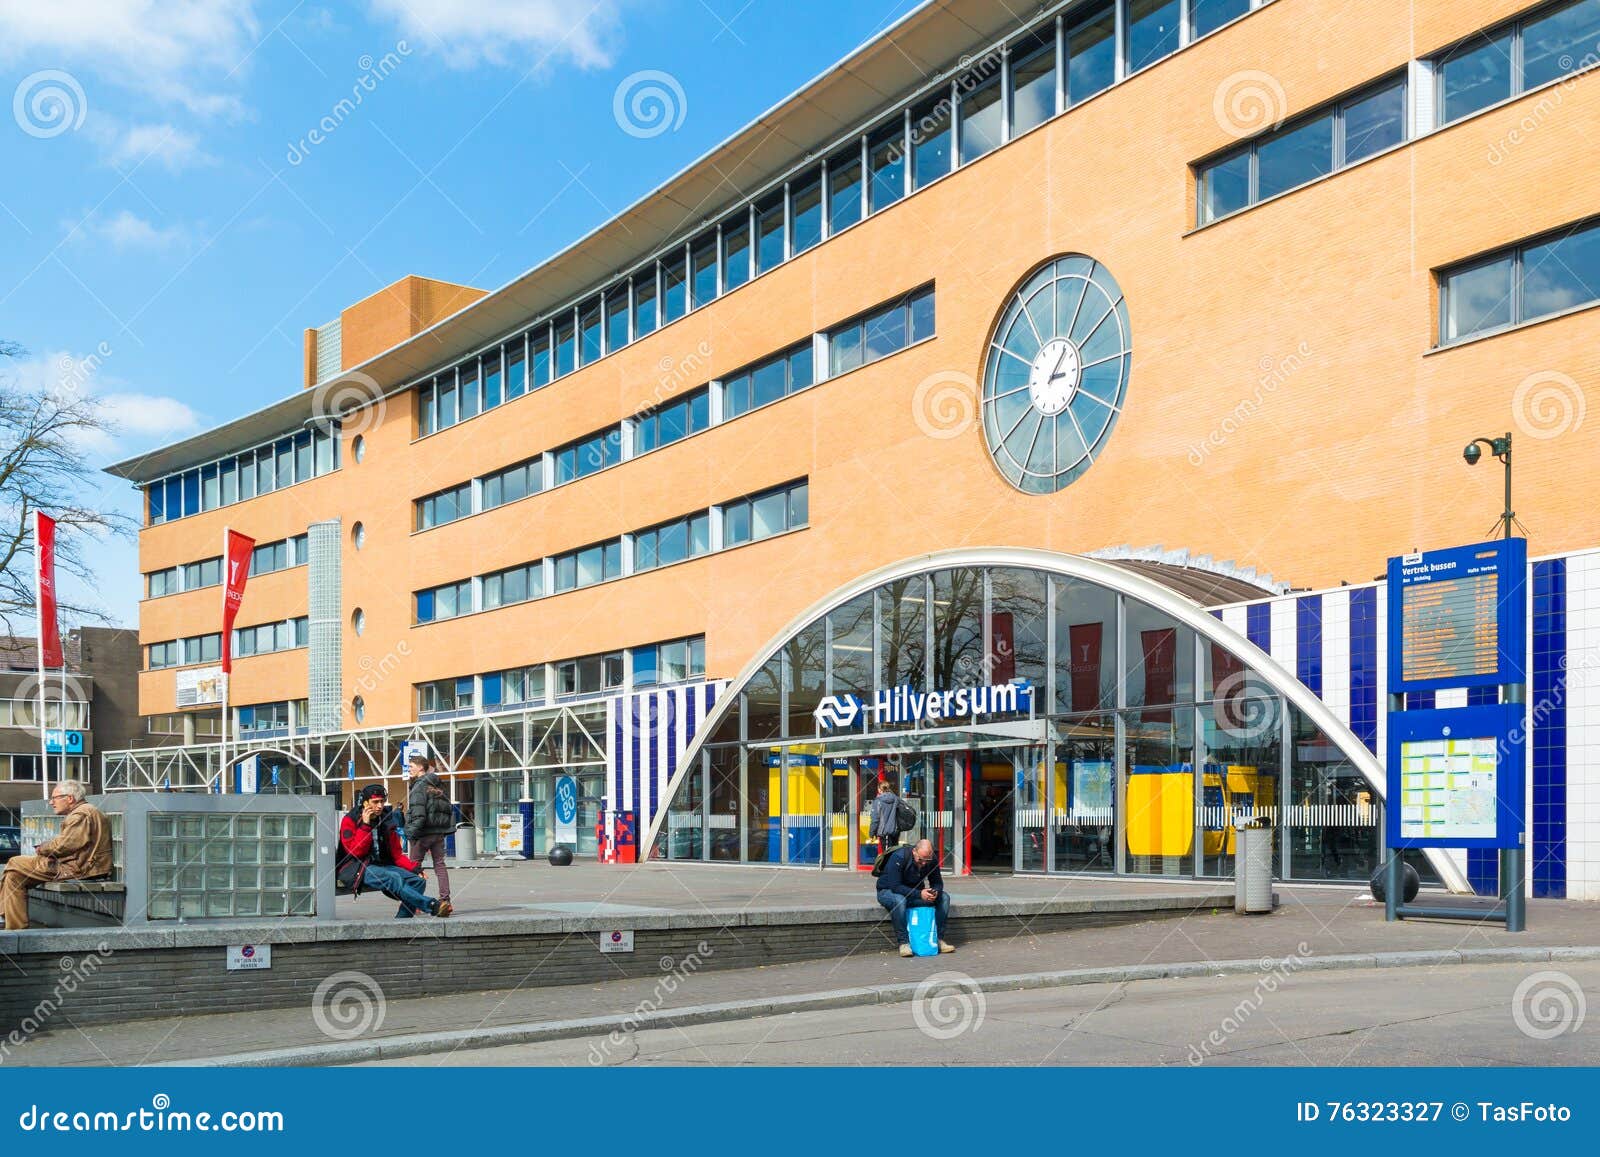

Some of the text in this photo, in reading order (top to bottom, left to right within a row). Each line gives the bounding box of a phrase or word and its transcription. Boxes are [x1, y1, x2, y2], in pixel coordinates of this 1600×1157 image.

[1402, 561, 1457, 576] Vertrek bussen
[873, 683, 1018, 723] Hilversum
